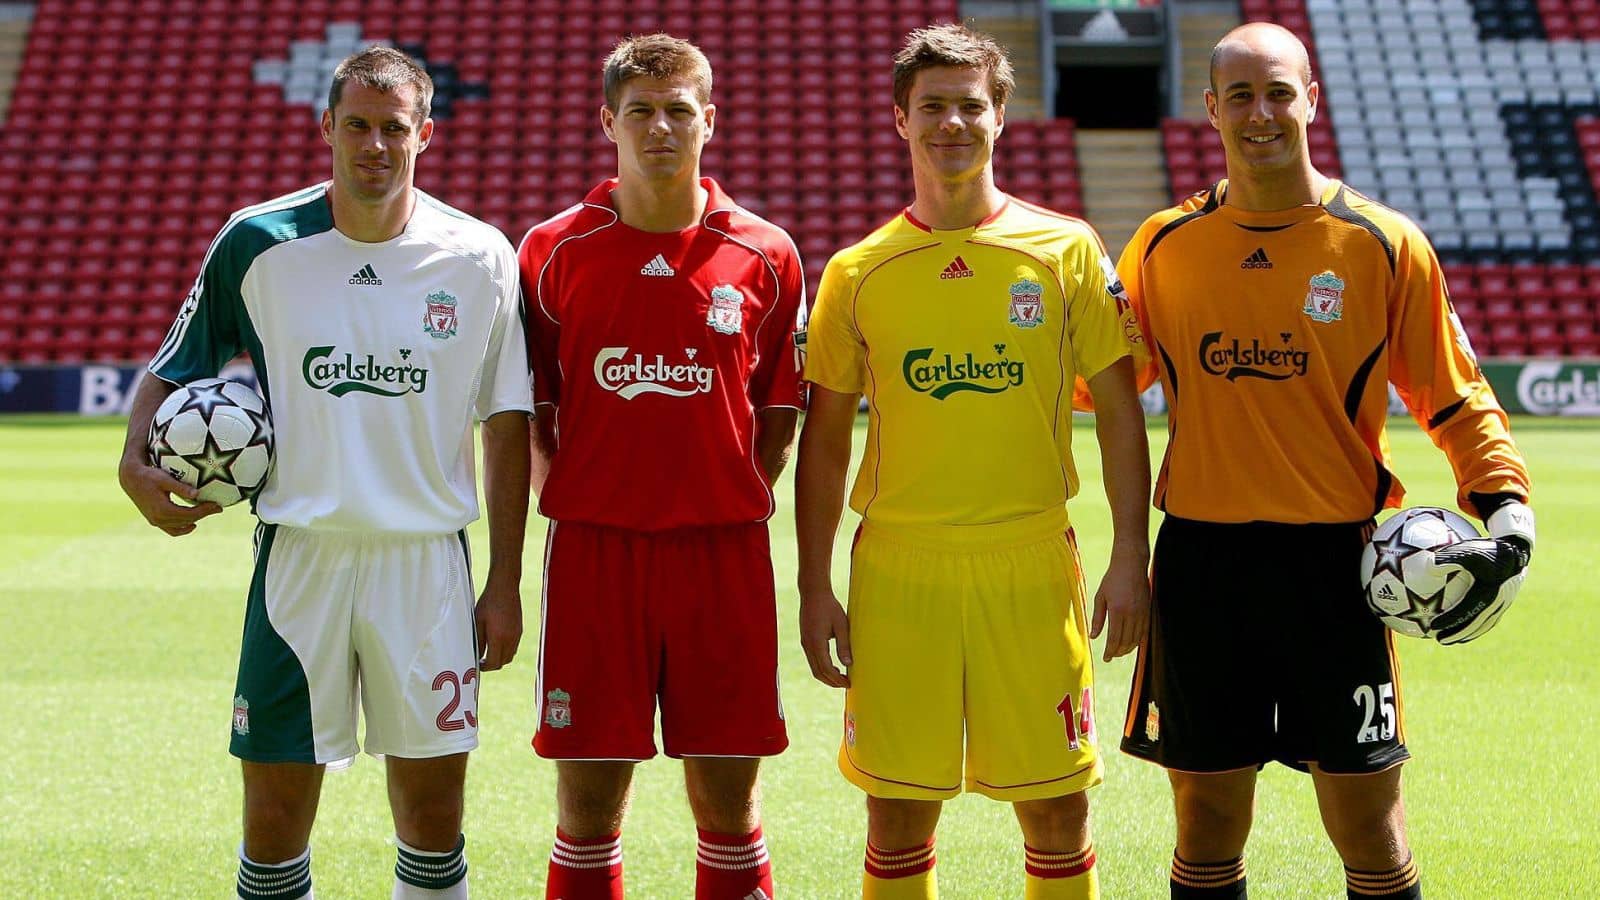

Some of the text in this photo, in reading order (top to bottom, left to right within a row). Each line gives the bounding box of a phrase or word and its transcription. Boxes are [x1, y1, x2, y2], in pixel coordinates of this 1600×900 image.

[349, 277, 382, 286] adidas
[641, 268, 675, 277] adidas
[940, 269, 974, 280] adidas
[1240, 261, 1273, 270] adidas
[302, 345, 429, 398] Carlsberg
[594, 346, 715, 400] Carlsberg
[903, 347, 1025, 401] Carlsberg
[1199, 331, 1311, 383] Carlsberg
[1516, 361, 1600, 415] Carls
[432, 668, 479, 731] 23
[1056, 688, 1093, 751] 14
[1353, 682, 1396, 744] 25
